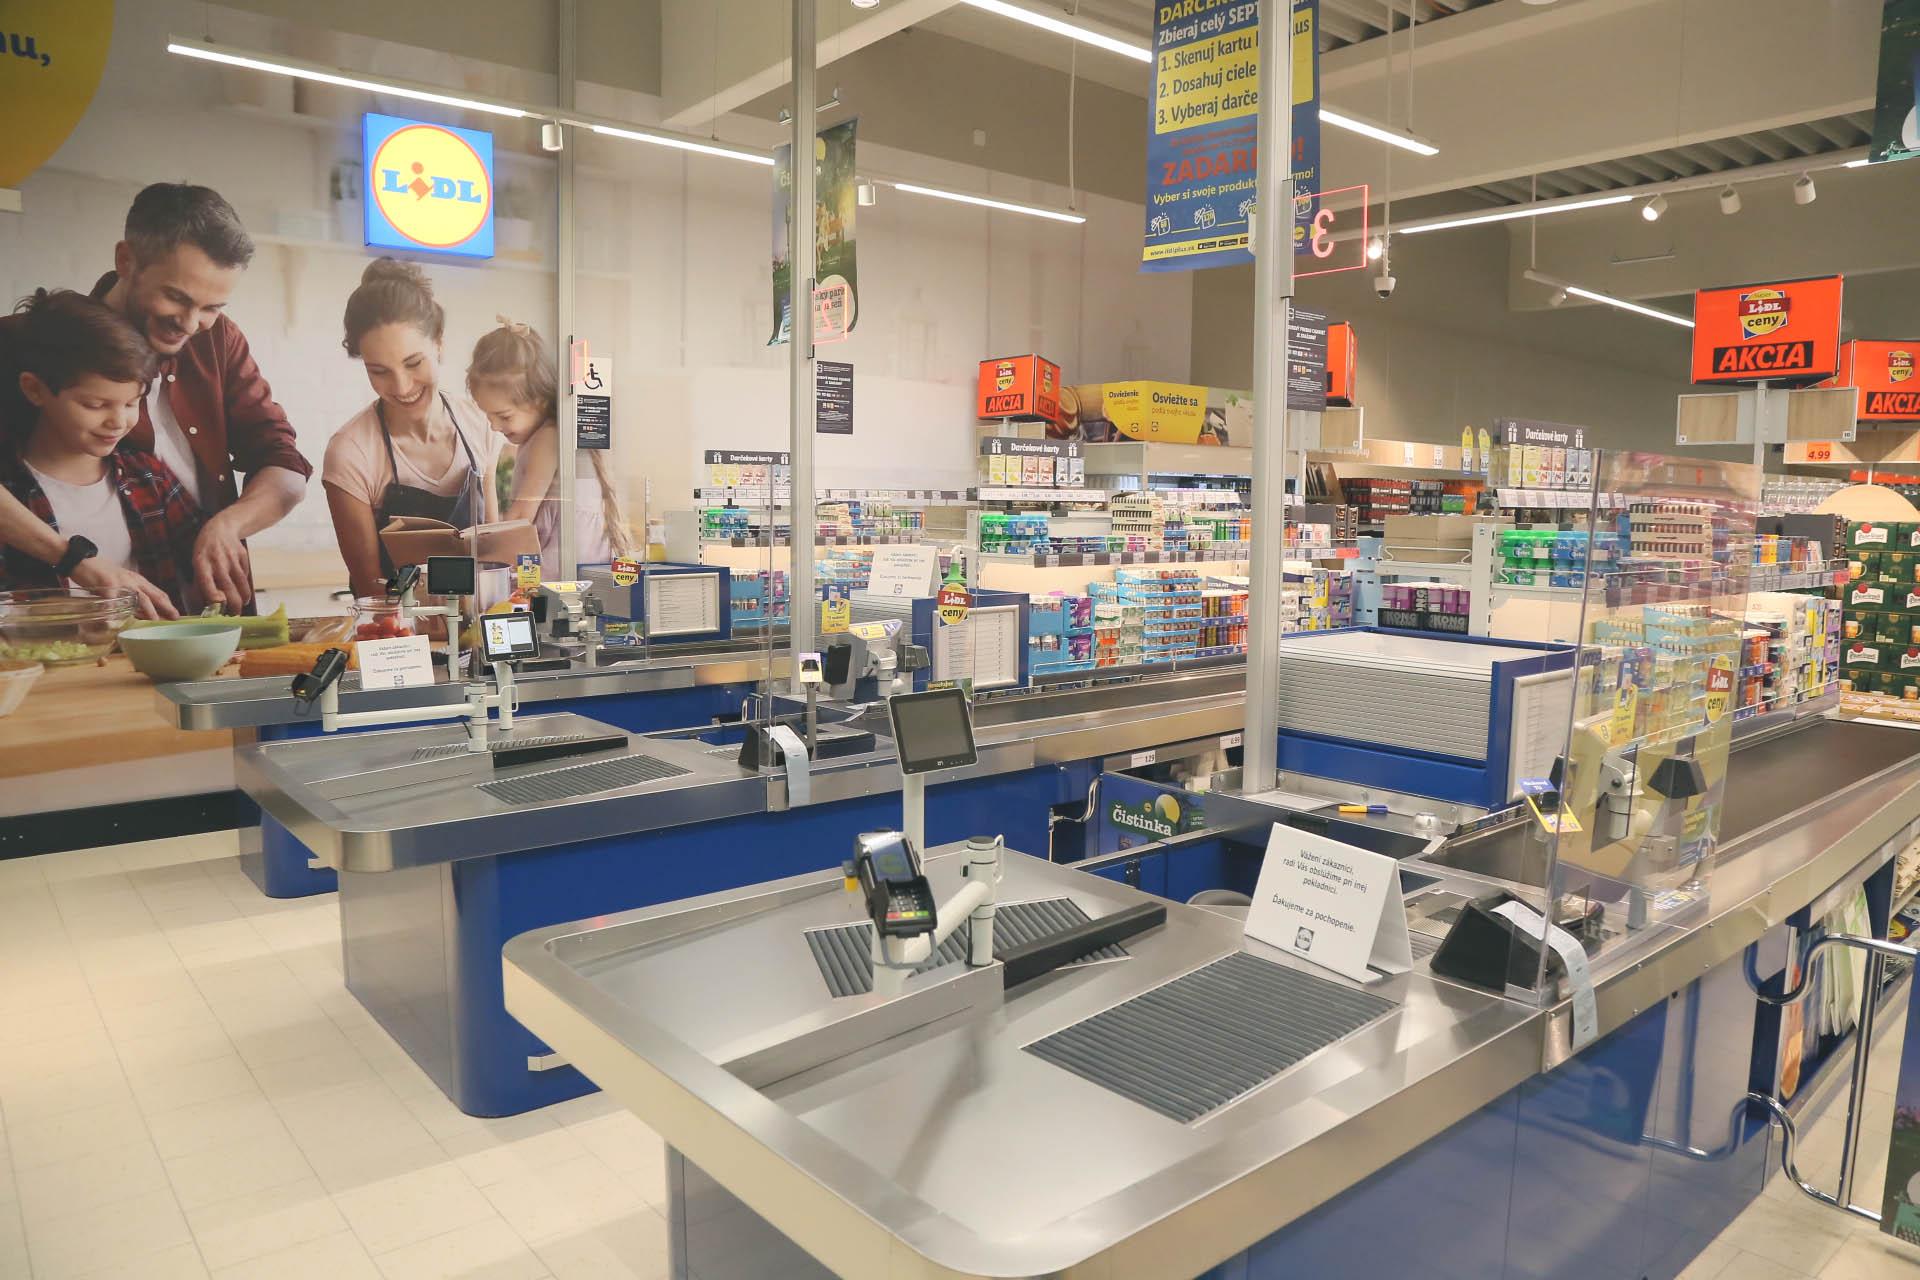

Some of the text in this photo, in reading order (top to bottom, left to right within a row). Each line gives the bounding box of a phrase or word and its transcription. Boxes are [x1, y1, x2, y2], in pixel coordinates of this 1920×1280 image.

[1158, 20, 1199, 46] Zbieraj
[1200, 11, 1225, 32] celý
[1160, 56, 1171, 72] 1.
[1174, 42, 1214, 69] Skenuj
[1217, 36, 1251, 57] kartu
[1160, 61, 1256, 98] 2. Dosahuj ciele
[1158, 89, 1258, 126] 3. Vyberaj darče
[1153, 190, 1180, 205] Vyber
[1182, 188, 1190, 200] si
[1191, 184, 1216, 199] svoje
[1747, 315, 1780, 327] ceny
[1718, 343, 1805, 371] AKCIA
[987, 394, 1021, 412] AKCIA
[1152, 392, 1188, 406] Osviežte
[1190, 398, 1198, 407] sa
[1808, 450, 1831, 460] 4.99
[616, 574, 634, 582] ceny
[942, 609, 964, 619] ceny
[1707, 697, 1725, 712] ceny
[1112, 804, 1172, 837] Čistinka
[1282, 858, 1296, 867] radi
[1354, 879, 1368, 893] inej
[1272, 893, 1304, 913] Ďakujeme
[1305, 908, 1314, 917] za
